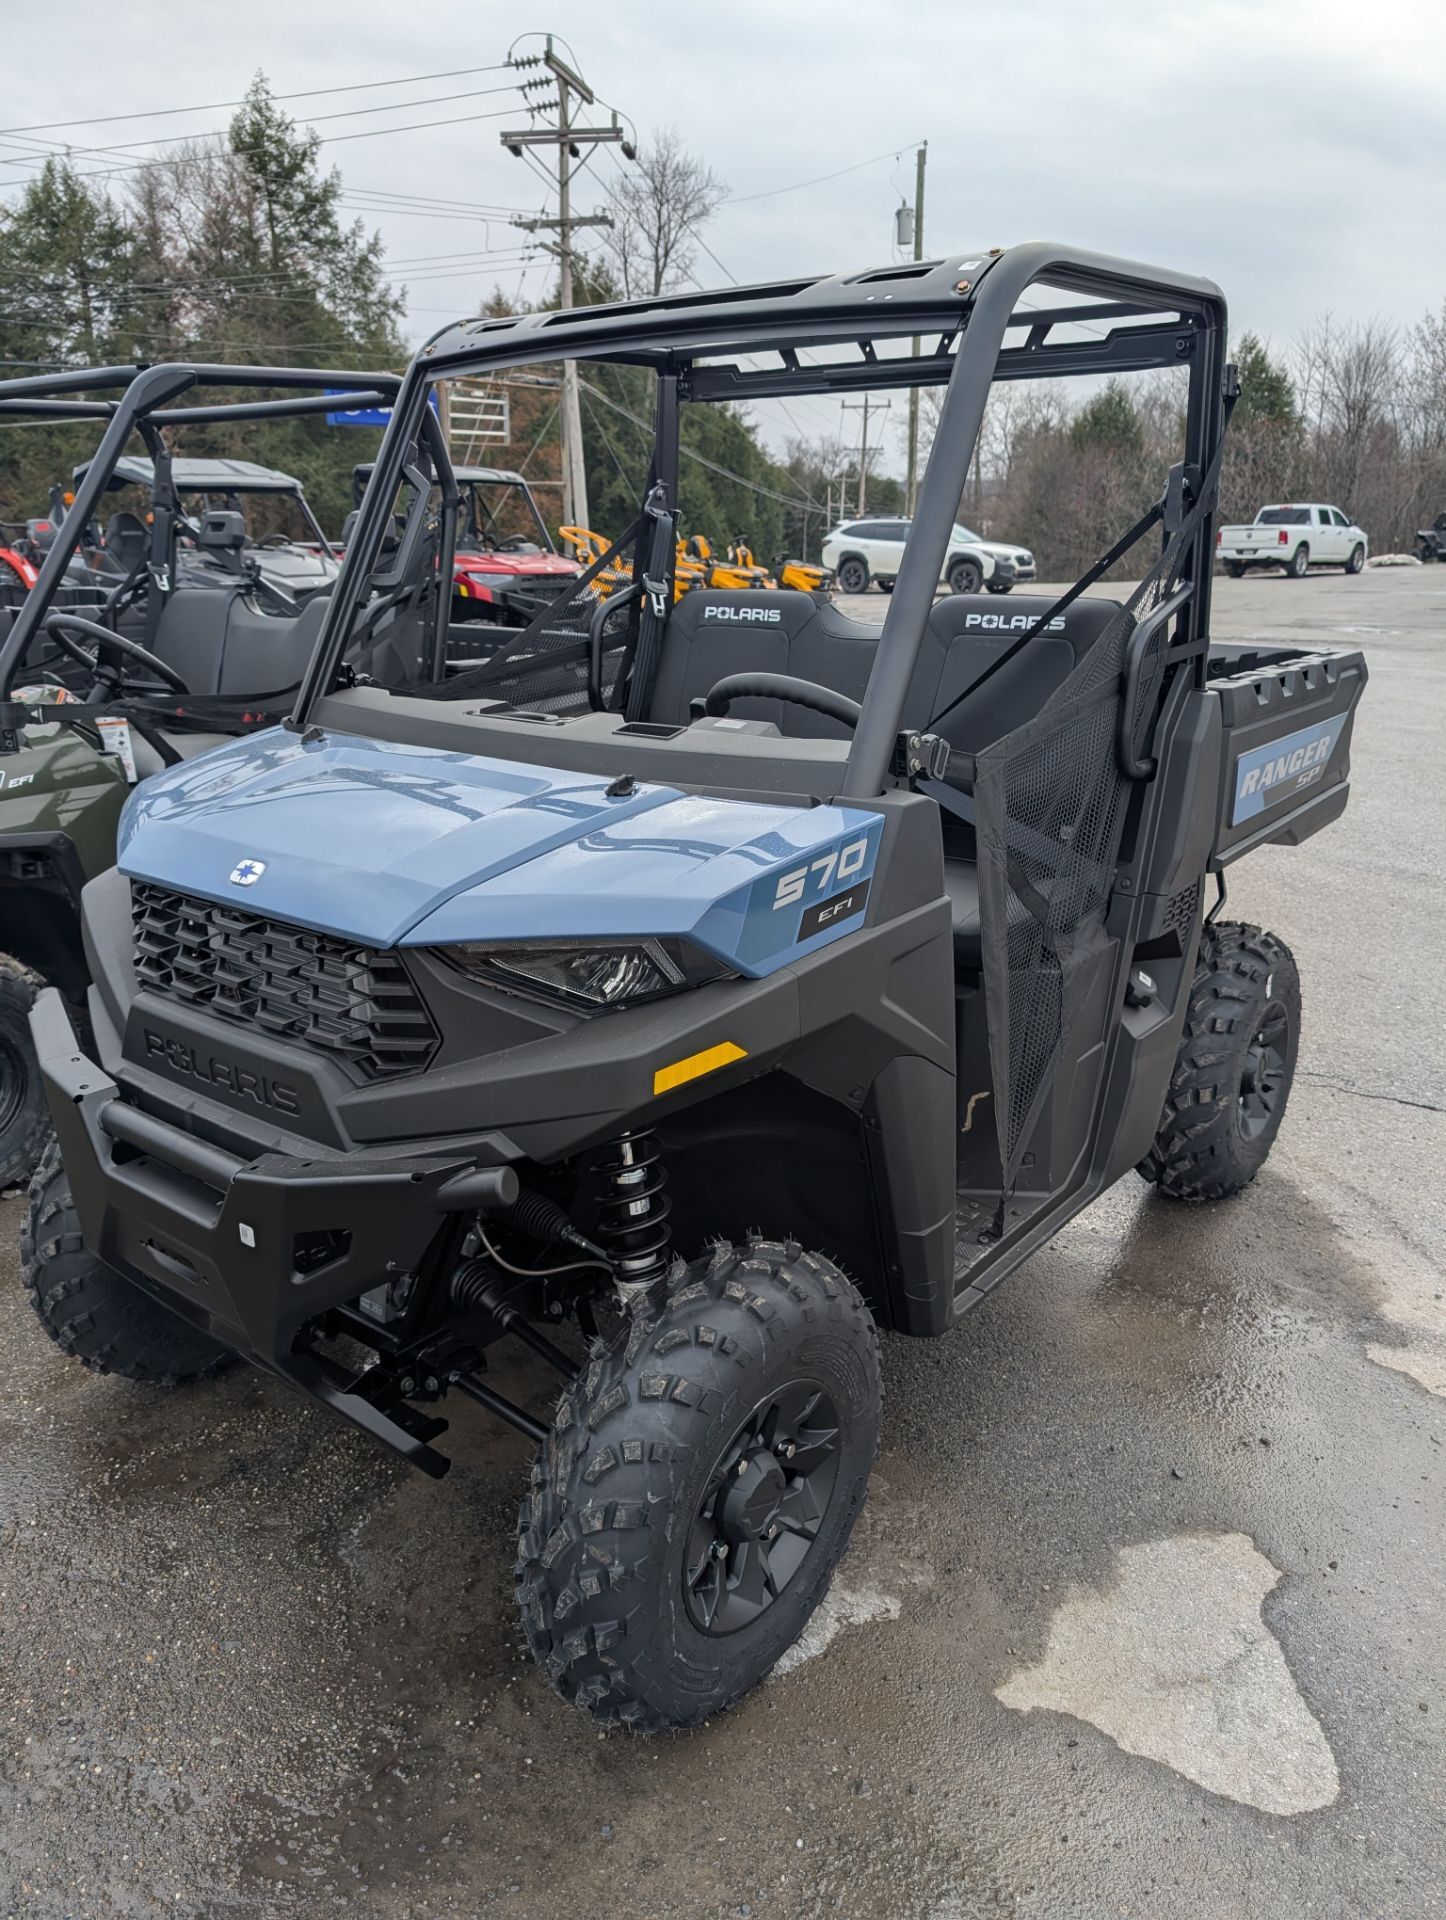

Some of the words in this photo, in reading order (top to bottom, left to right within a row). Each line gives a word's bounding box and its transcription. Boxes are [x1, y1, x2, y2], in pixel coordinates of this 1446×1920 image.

[704, 606, 782, 622] POLARIS
[965, 613, 1066, 631] POLARS
[1239, 735, 1331, 800] RANGER
[1295, 765, 1321, 789] SP
[8, 773, 35, 789] EFI
[772, 838, 868, 911] 570
[817, 896, 853, 923] EFI
[144, 1029, 301, 1117] POLARIS
